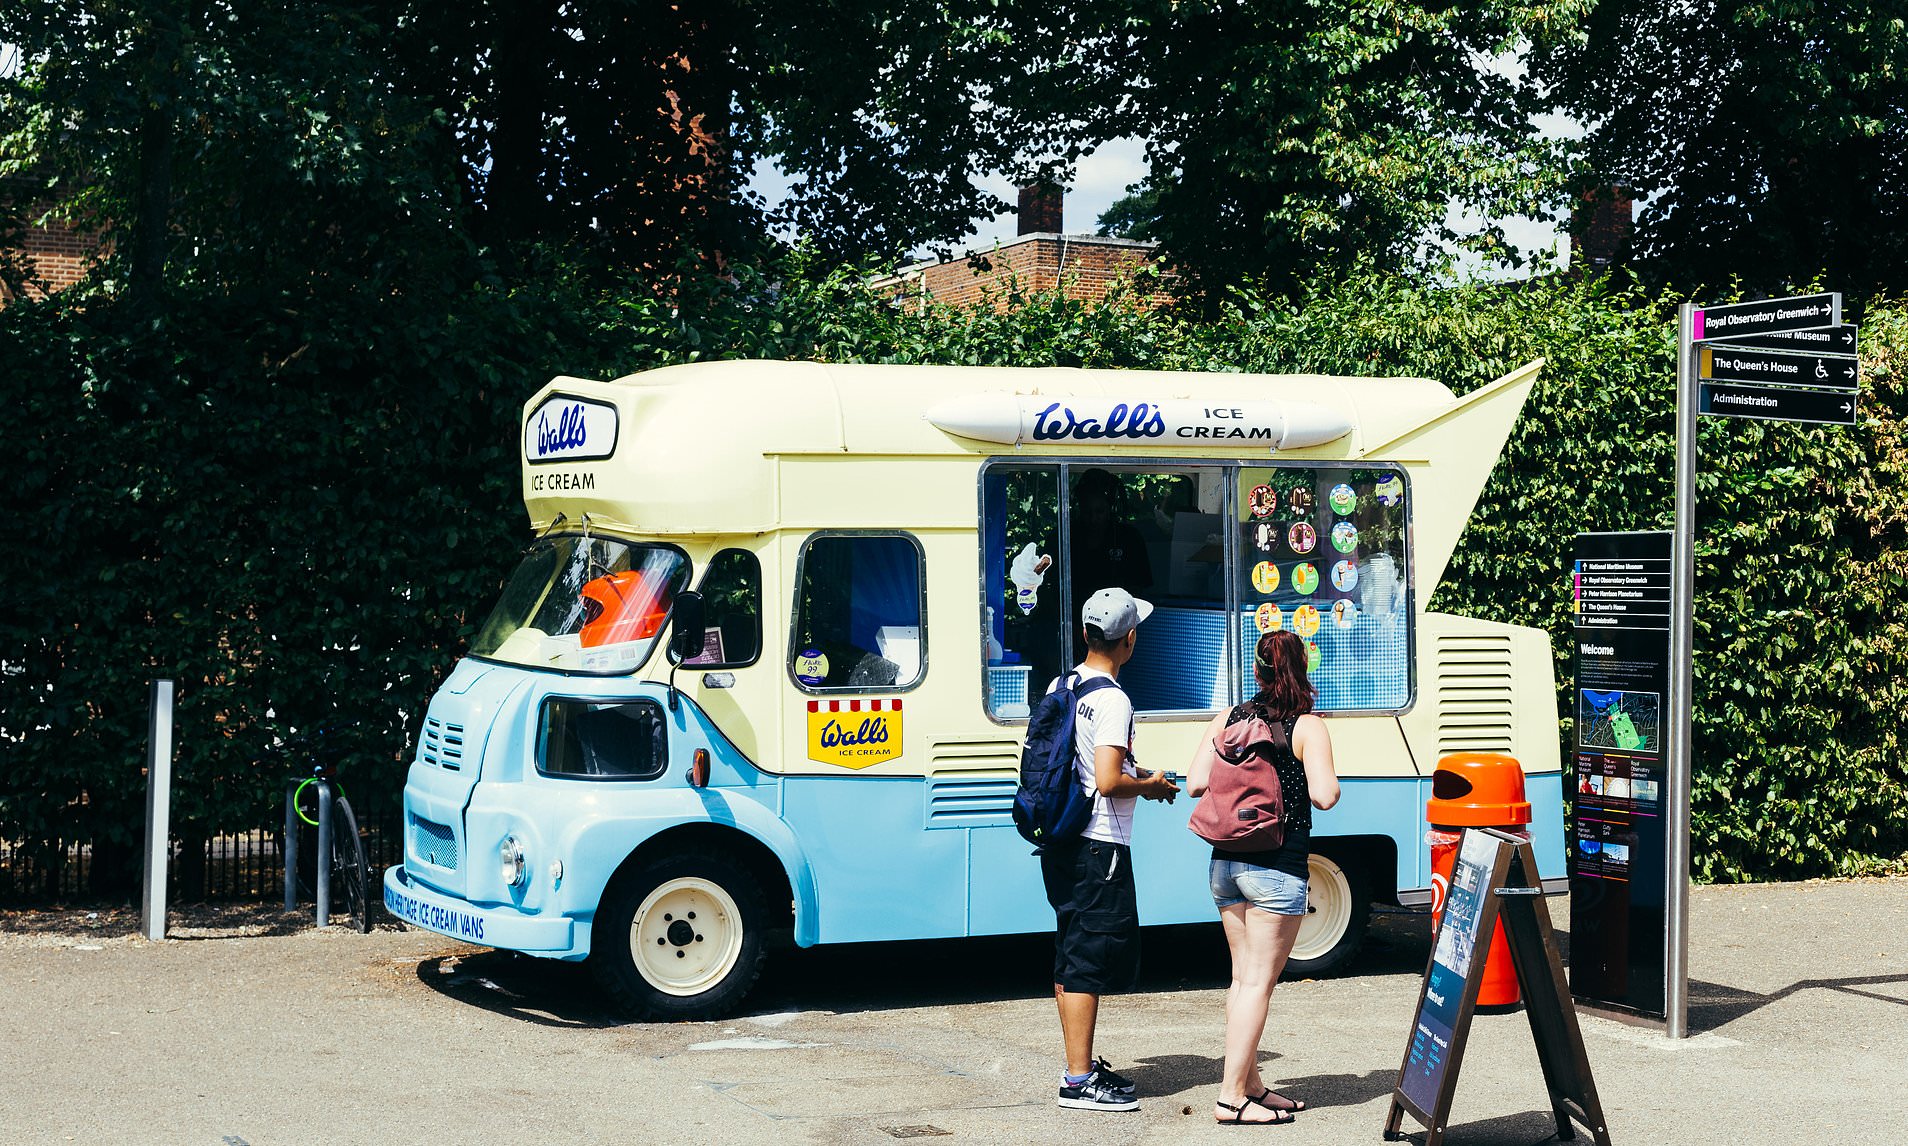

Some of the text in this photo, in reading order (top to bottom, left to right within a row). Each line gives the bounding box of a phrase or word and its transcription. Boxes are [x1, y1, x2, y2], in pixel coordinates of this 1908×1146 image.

[1706, 306, 1819, 329] Royal Observatory Greenwich
[1714, 357, 1799, 373] The Queen's House
[1713, 393, 1778, 407] Administration
[1033, 402, 1166, 441] Wall's
[1205, 408, 1244, 419] ICE
[538, 404, 586, 456] Wall's
[1176, 426, 1272, 439] CREAM
[531, 472, 595, 491] ICE CREAM
[1588, 577, 1600, 585] Royal
[1600, 577, 1625, 585] Observatory
[1580, 644, 1614, 655] Welcome
[821, 717, 889, 748] Wall's
[419, 901, 429, 925] ICE
[431, 906, 458, 934] CREAM
[460, 913, 484, 940] VANS
